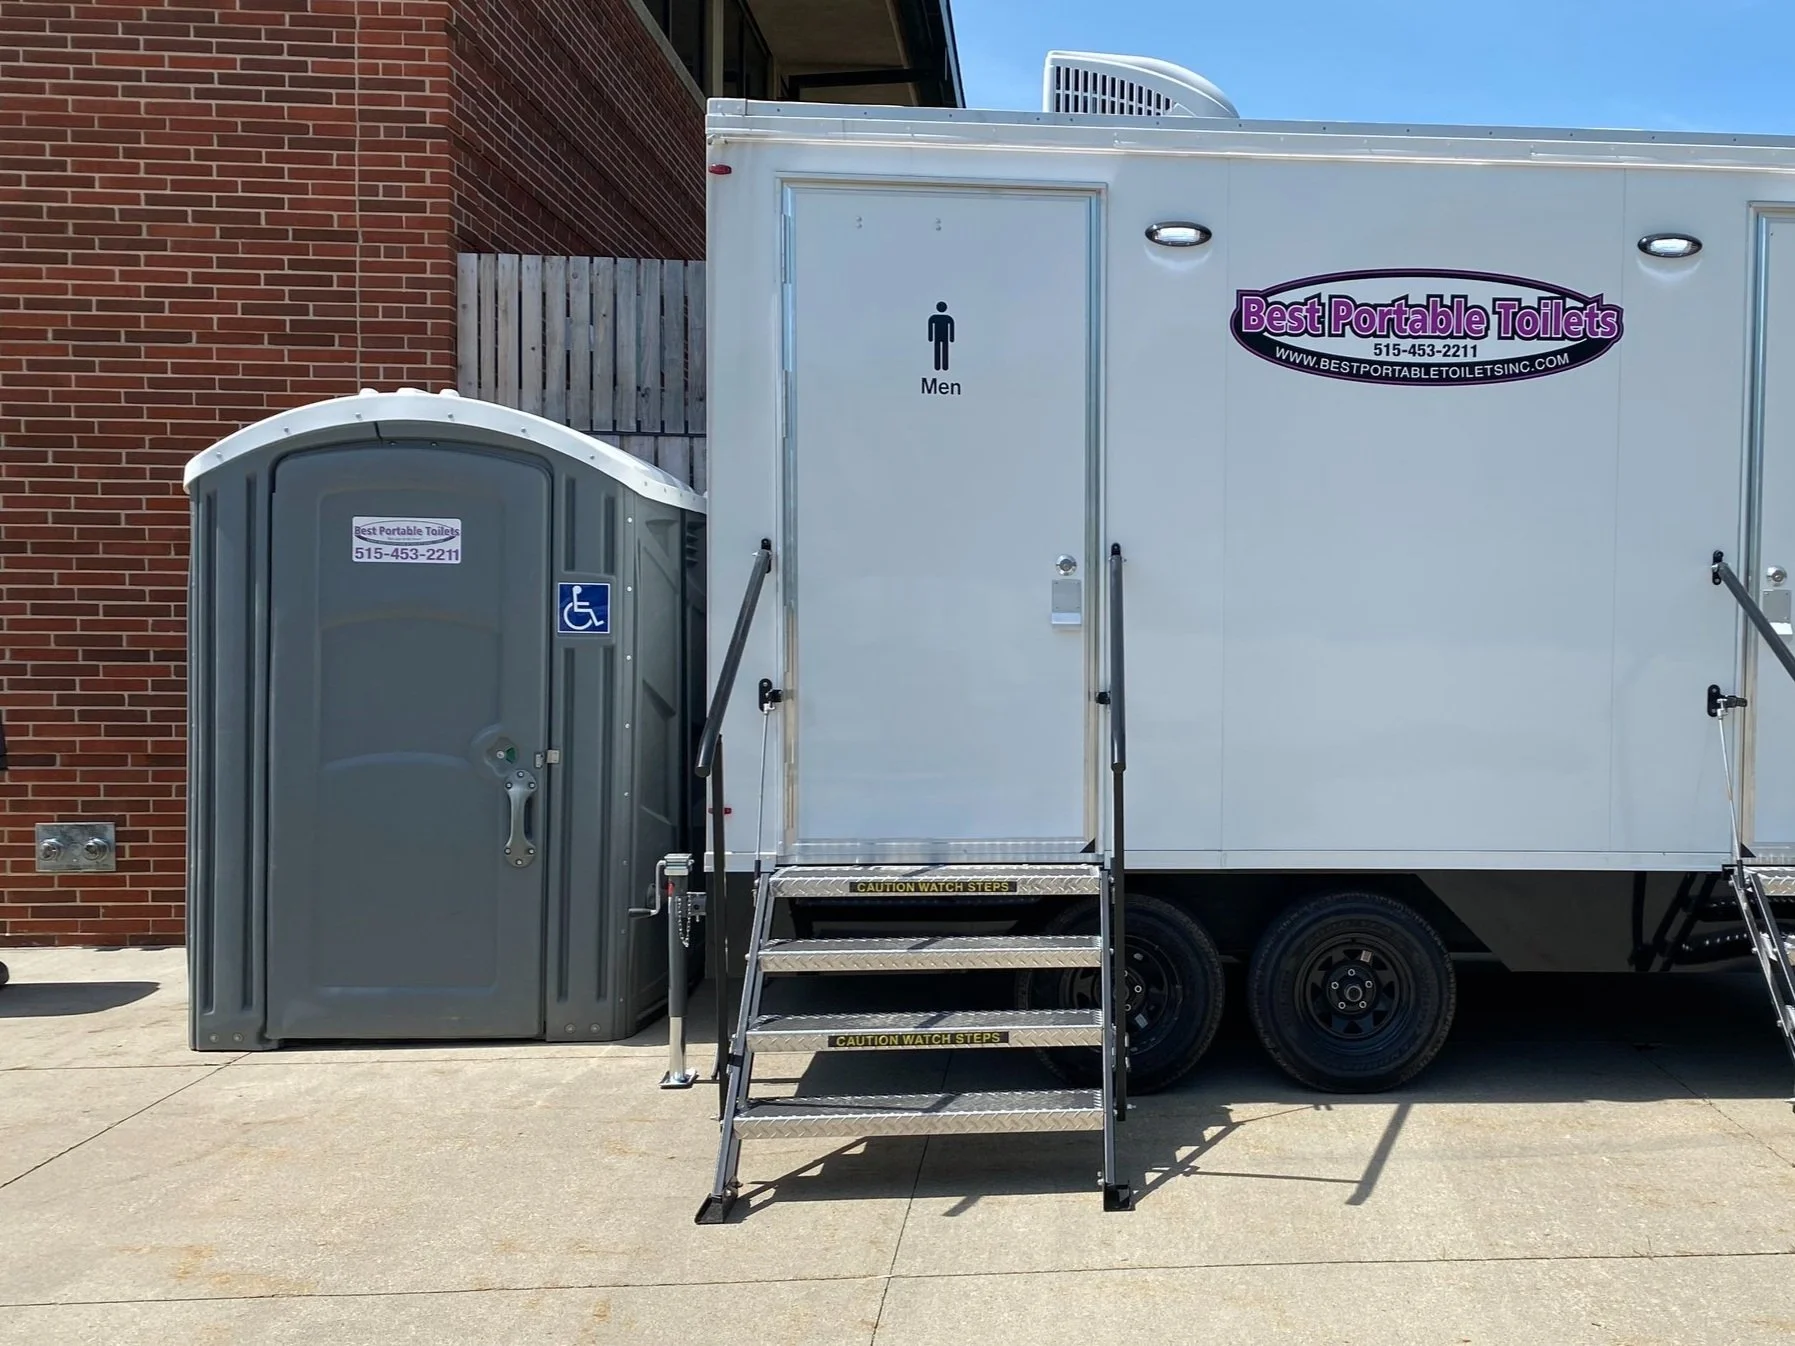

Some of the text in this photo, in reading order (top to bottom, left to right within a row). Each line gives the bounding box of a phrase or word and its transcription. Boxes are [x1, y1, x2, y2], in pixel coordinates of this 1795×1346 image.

[1242, 296, 1618, 339] Best Portable Toilets
[1373, 342, 1478, 359] 515-453-2211
[1275, 346, 1570, 379] WWW.BESTPORTABLETOILETSINC.COM
[921, 377, 961, 395] Men
[354, 525, 460, 537] Best Portable Toilets
[354, 546, 460, 561] 515-453-2211
[857, 882, 1009, 893] CAUTION WATCH STEPS
[836, 1032, 1001, 1047] CAUTION WATCH STEPS
